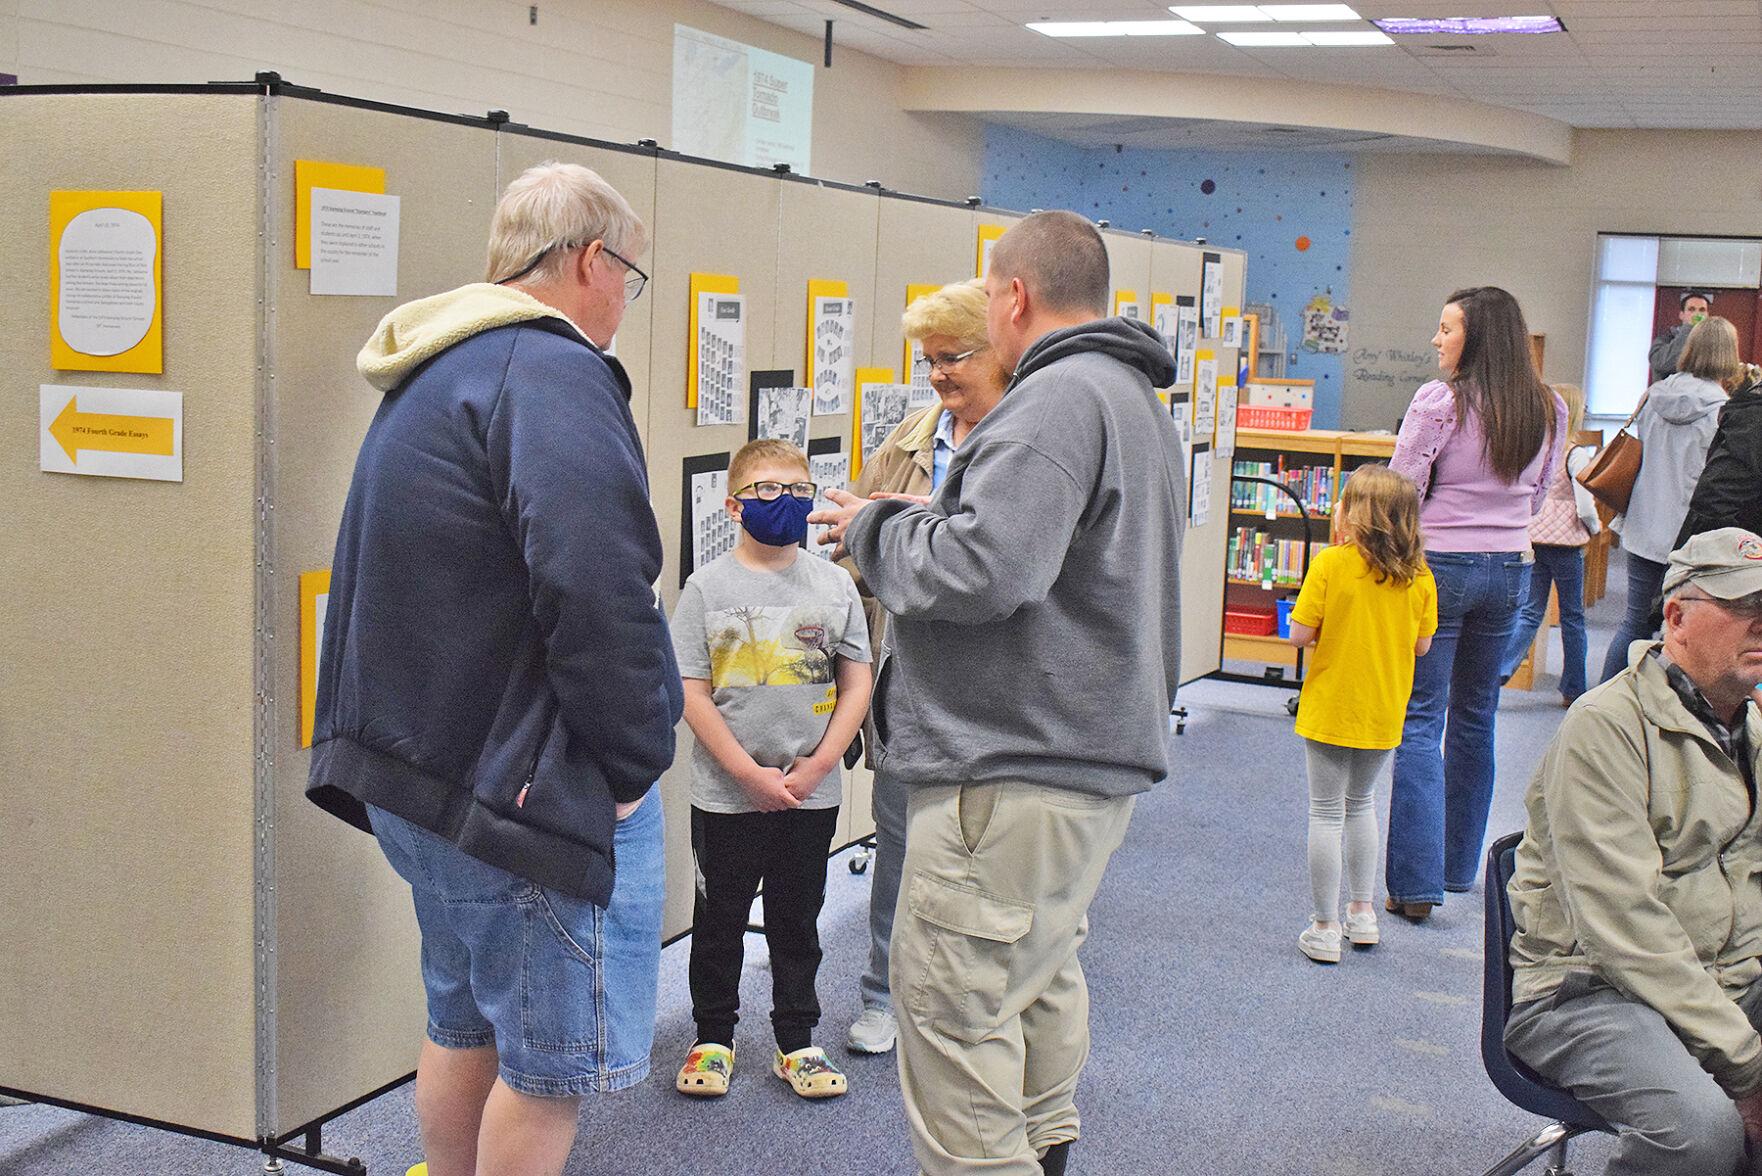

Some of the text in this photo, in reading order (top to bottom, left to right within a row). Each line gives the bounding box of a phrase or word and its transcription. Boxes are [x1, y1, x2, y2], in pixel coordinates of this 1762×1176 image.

[769, 75, 788, 90] Super
[753, 87, 778, 104] Tornado
[752, 103, 780, 119] Outbreak
[1353, 348, 1380, 364] Amy
[1352, 368, 1395, 387] Reading
[72, 426, 149, 440] 1974 Fourth Grade Essays
